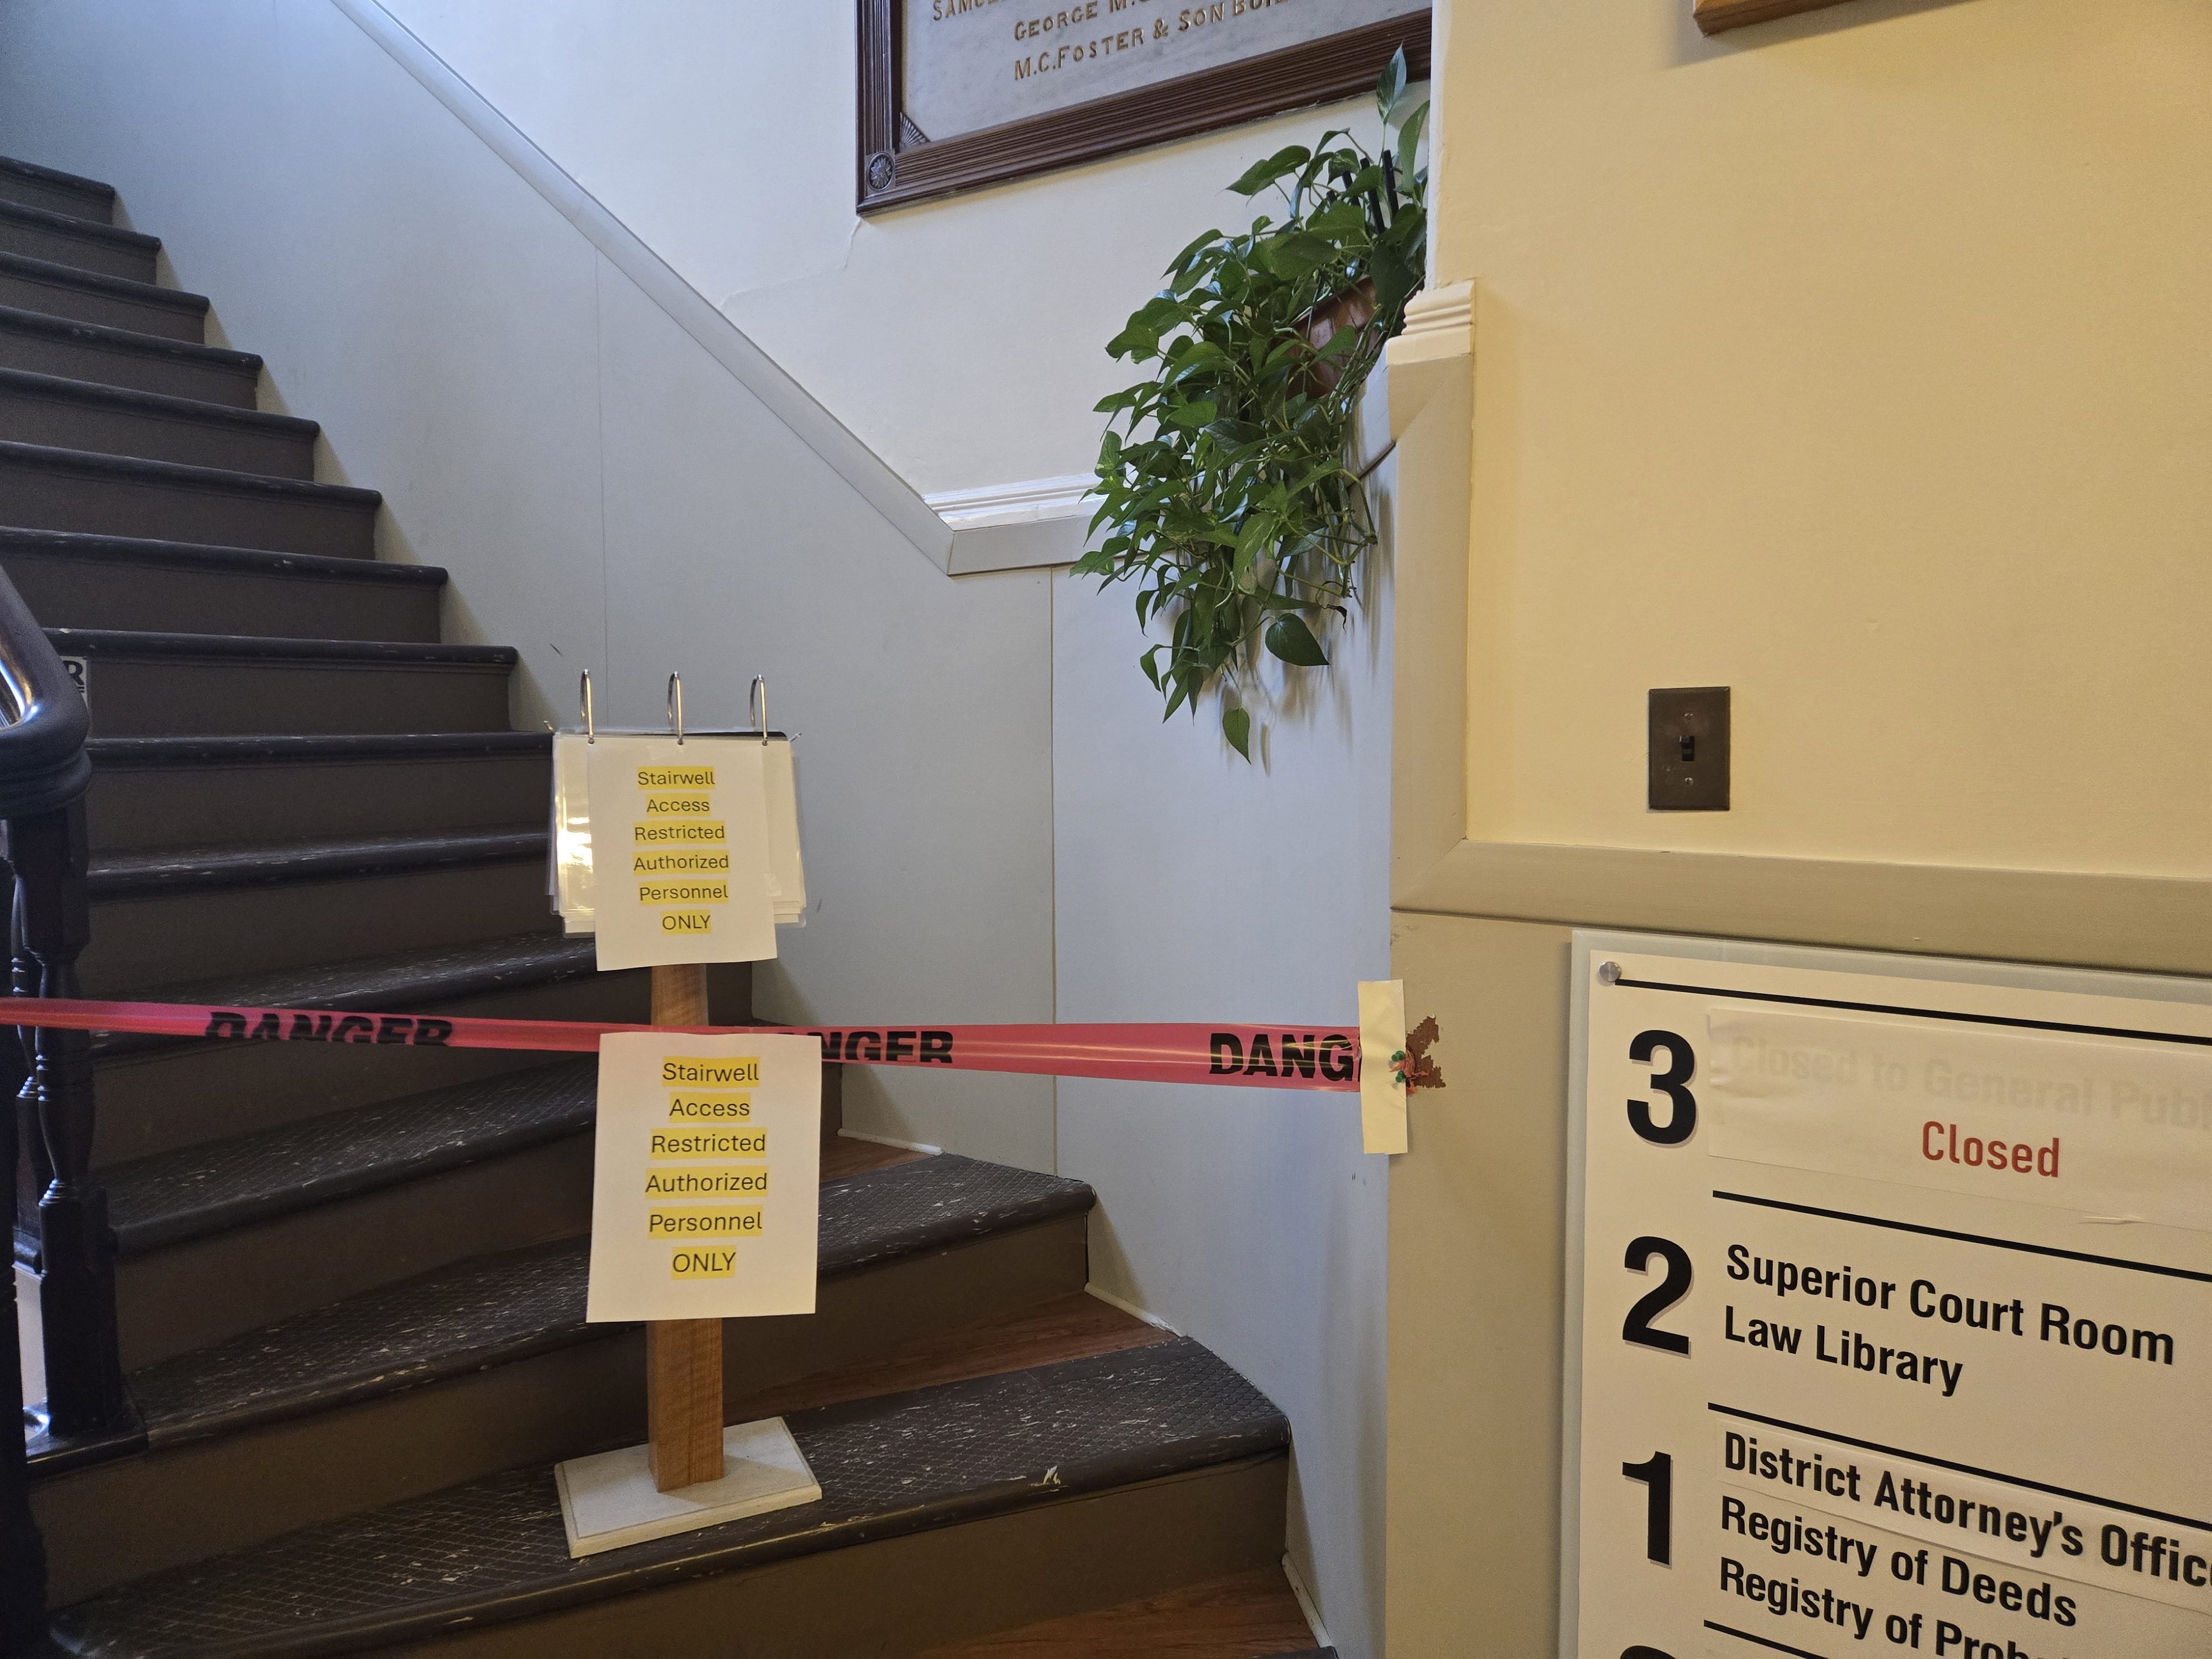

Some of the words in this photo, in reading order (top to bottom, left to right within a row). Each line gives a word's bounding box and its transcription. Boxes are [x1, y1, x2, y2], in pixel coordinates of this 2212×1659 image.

[1014, 1, 1098, 41] GEORGE
[1153, 18, 1169, 40] &
[1178, 2, 1224, 32] SON
[638, 770, 714, 785] Stairwell
[646, 799, 709, 812] Access
[635, 825, 724, 839] Restricted
[634, 855, 728, 869] Authorized
[639, 885, 728, 900] Personnel
[662, 915, 711, 929] ONLY
[775, 1031, 954, 1063] NGER
[1209, 1032, 1360, 1082] DANG
[662, 1063, 759, 1082] Stairwell
[1627, 1030, 1697, 1145] 3
[1873, 1052, 1908, 1092] to
[1923, 1058, 2093, 1116] General
[669, 1099, 750, 1117] Access
[651, 1134, 766, 1153] Restricted
[1922, 1120, 2060, 1178] Closed
[645, 1173, 767, 1193] Authorized
[649, 1212, 763, 1232] Personnel
[672, 1252, 736, 1272] ONLY
[1623, 1236, 1693, 1355] 2
[1727, 1244, 1896, 1310] Superior
[1910, 1280, 2024, 1336] Court
[2040, 1303, 2174, 1365] Room
[1725, 1306, 1802, 1354] Law
[1816, 1325, 1963, 1397] Library
[1622, 1451, 1672, 1566] 1
[1725, 1431, 1861, 1501] District
[1874, 1470, 2084, 1558] Attorney's
[2101, 1524, 2212, 1587] Offic
[1721, 1496, 1877, 1577] Registry
[1891, 1550, 1929, 1585] of
[1942, 1556, 2077, 1627] Deeds
[1720, 1557, 1874, 1640] Registry
[1885, 1613, 1923, 1649] of
